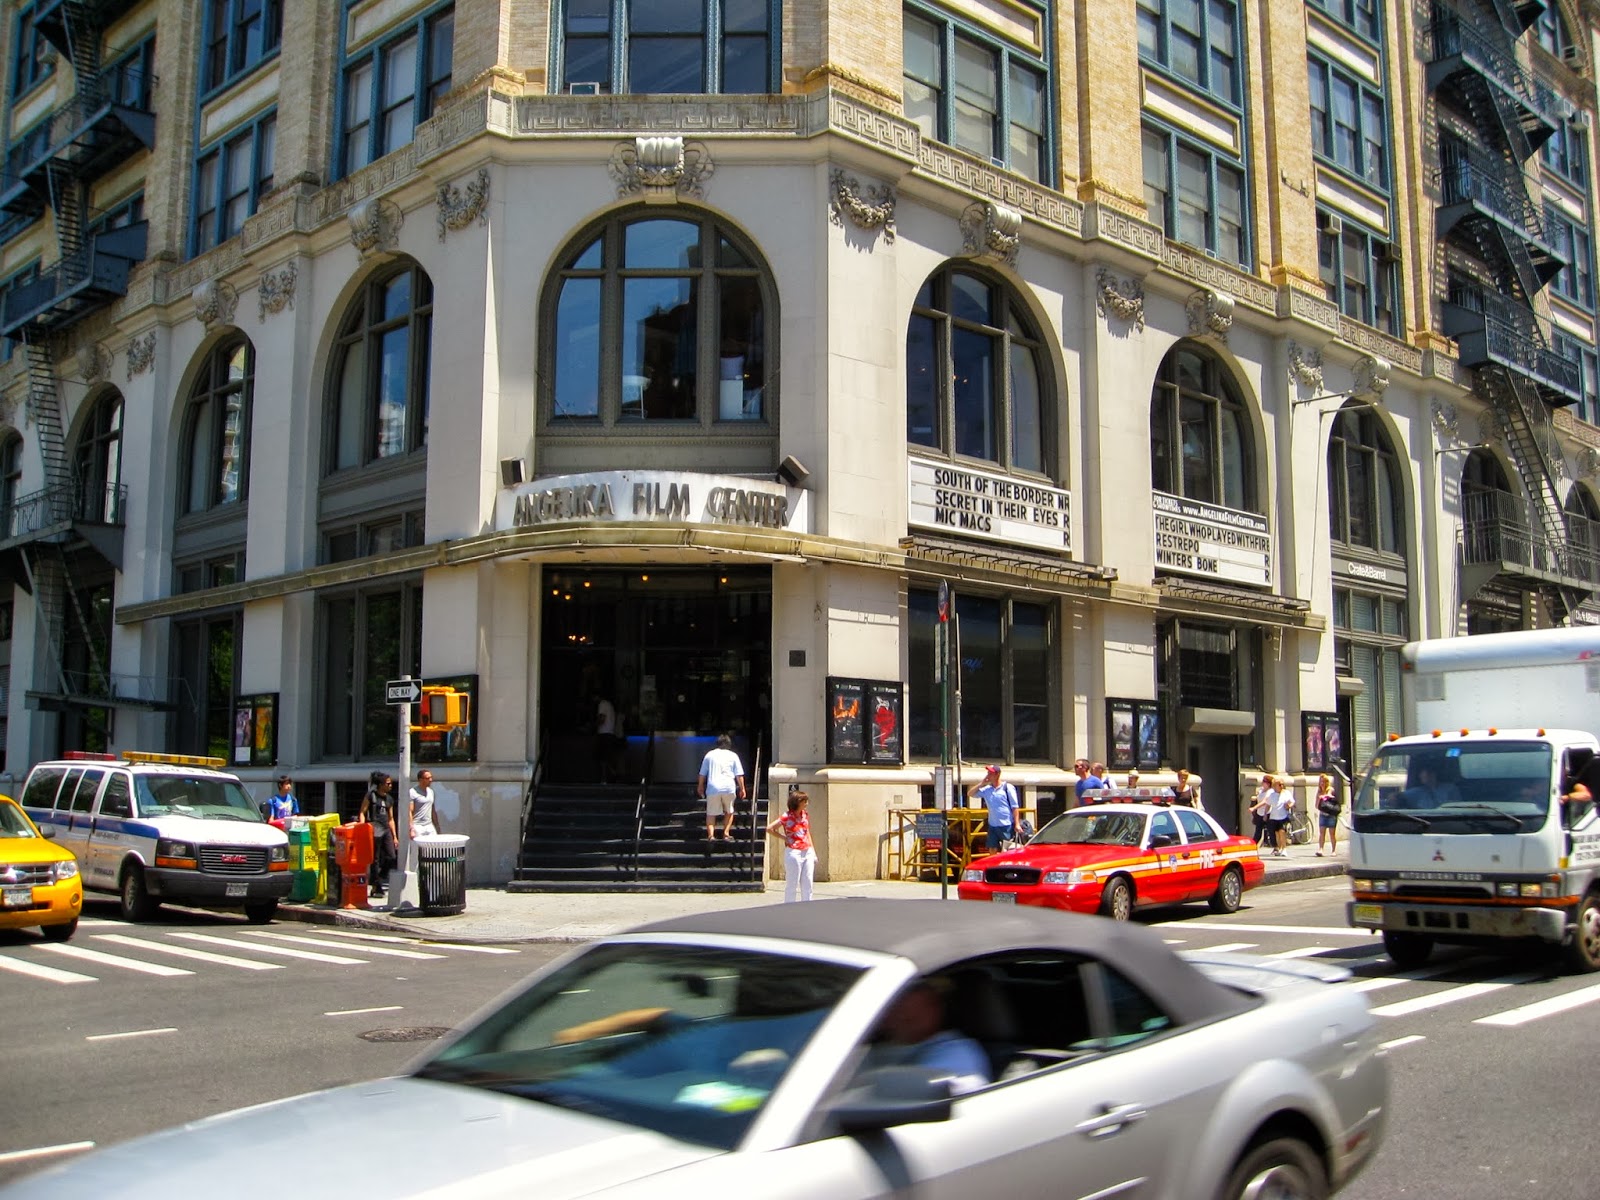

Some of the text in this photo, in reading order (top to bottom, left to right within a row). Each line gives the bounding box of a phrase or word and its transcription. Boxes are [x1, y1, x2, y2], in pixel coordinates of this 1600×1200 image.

[935, 469, 971, 491] SOUTH
[974, 478, 989, 494] OF
[993, 480, 1012, 500] THE
[1013, 482, 1054, 508] BORDER
[513, 482, 789, 530] ANGELIKA FILM CENTER
[936, 489, 978, 512] SECRET
[982, 499, 993, 515] IN
[997, 501, 1027, 520] THEIR
[1033, 508, 1058, 527] EYES
[935, 507, 956, 526] MIC
[959, 513, 992, 532] MACS
[1156, 532, 1199, 553] RESTREPO
[1156, 548, 1192, 569] WINTERS
[1197, 557, 1218, 573] BONE
[390, 687, 411, 697] ONE WAY
